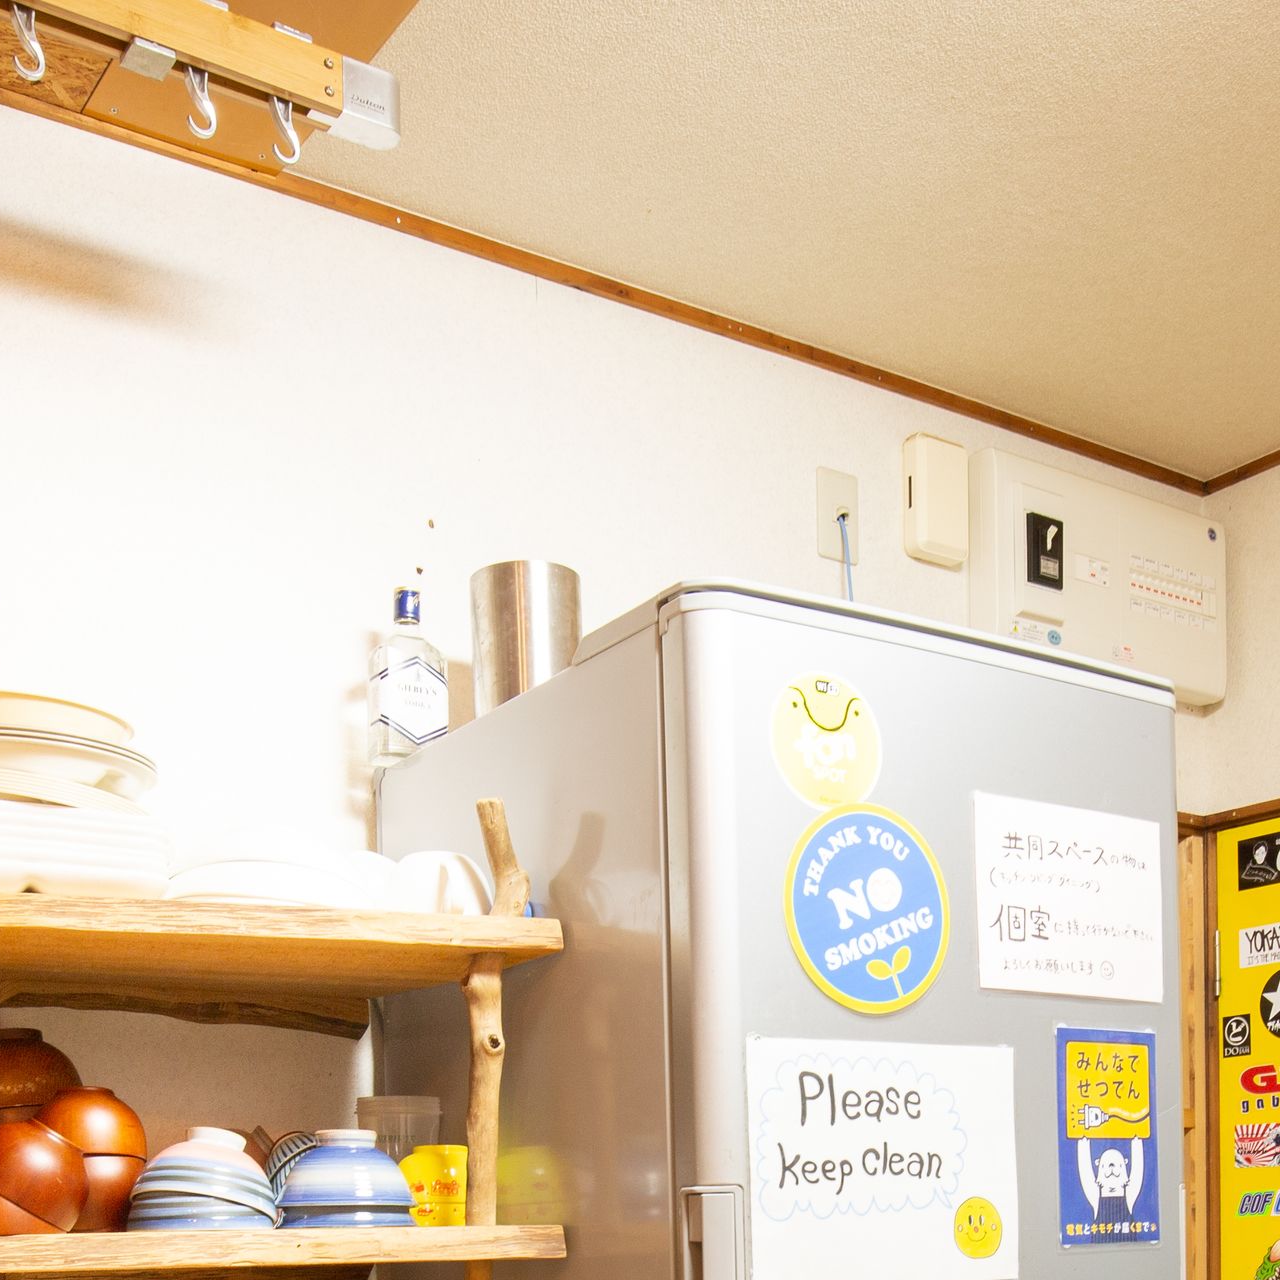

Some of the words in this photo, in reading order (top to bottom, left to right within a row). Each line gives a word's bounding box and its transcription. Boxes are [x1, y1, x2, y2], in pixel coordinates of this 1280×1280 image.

[803, 825, 862, 896] THANK
[866, 825, 910, 861] YOU
[827, 867, 902, 930] NO
[824, 906, 934, 971] SMOKING
[1076, 1051, 1140, 1074] みんなで
[1077, 1080, 1140, 1100] せつでん
[798, 1071, 922, 1128] Please
[778, 1142, 853, 1195] keep
